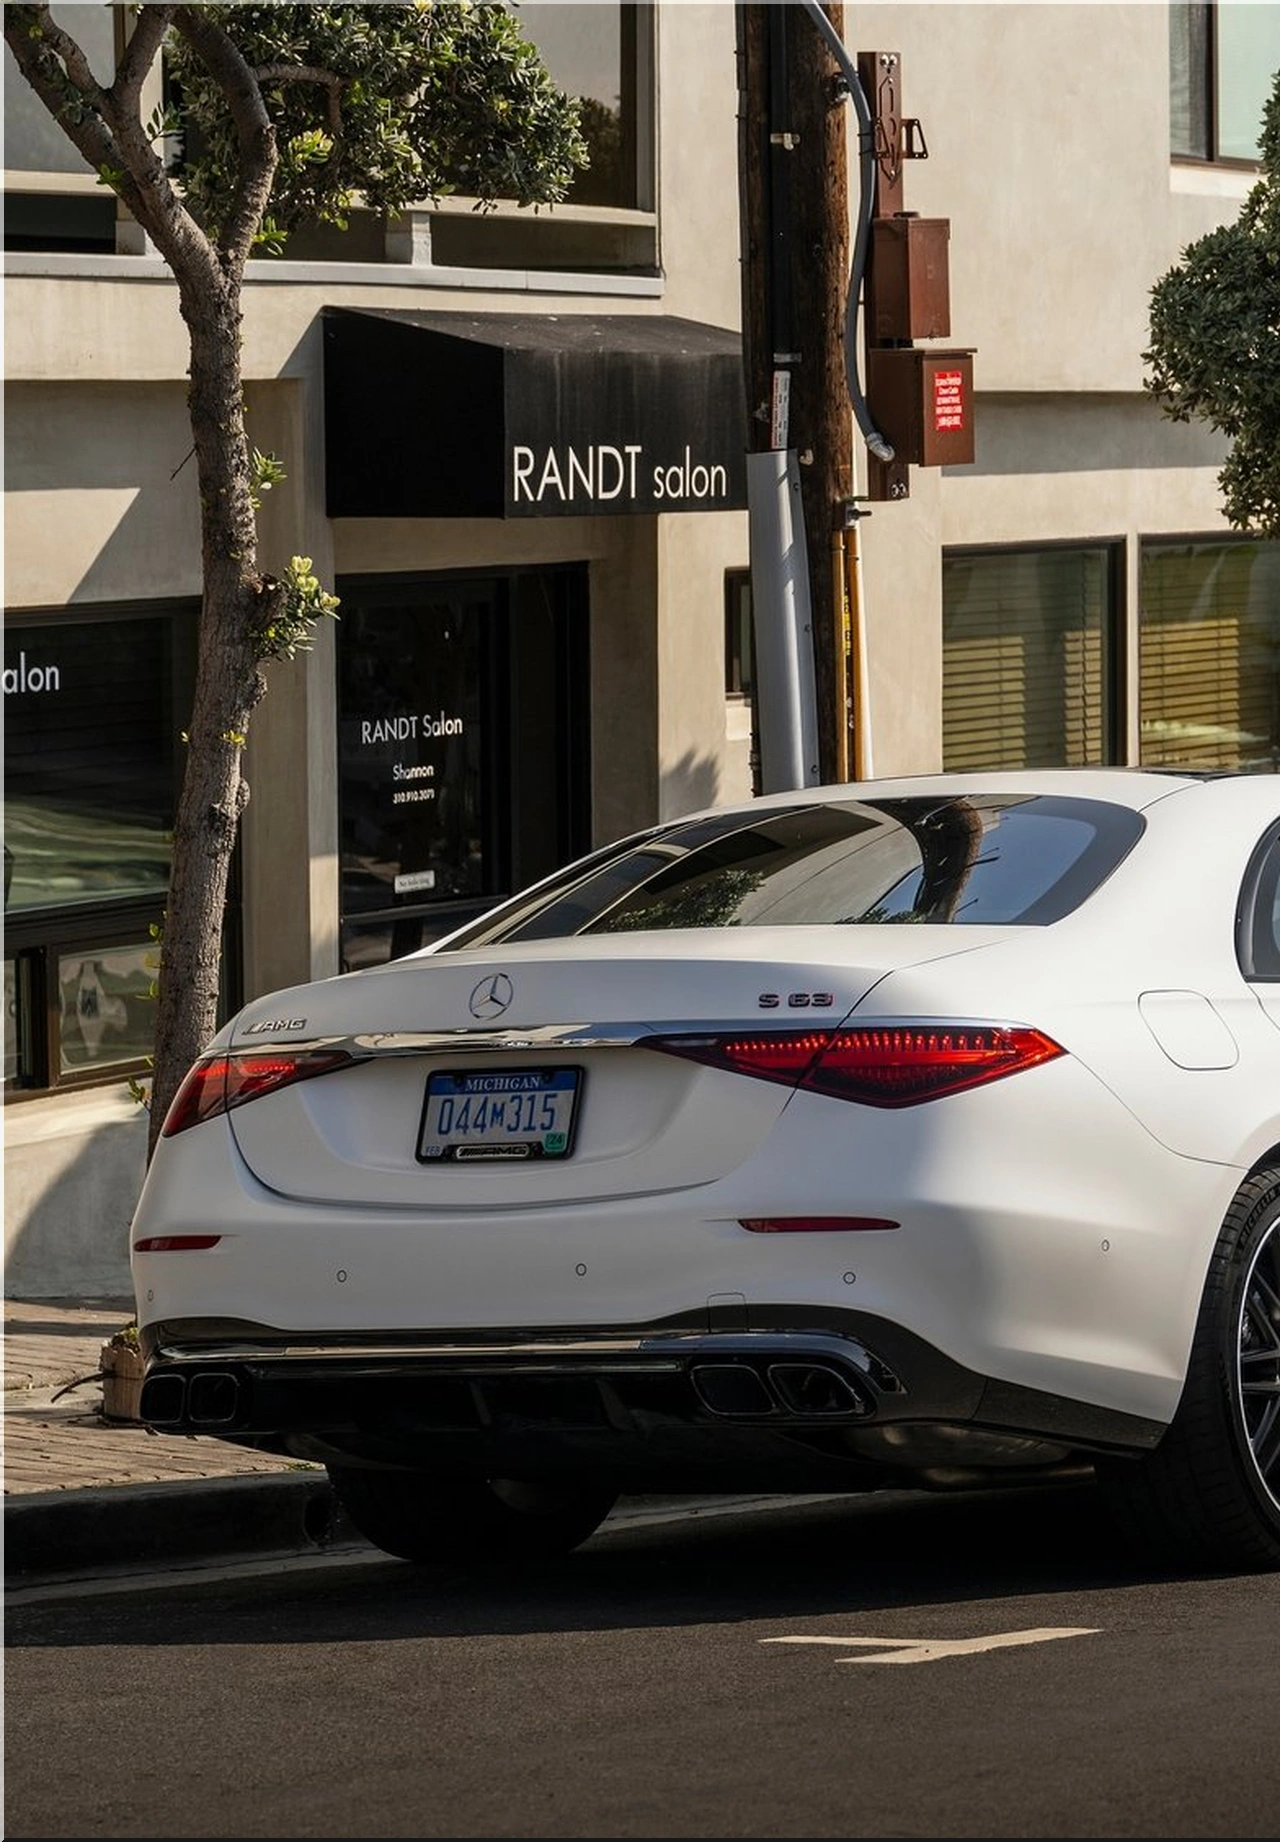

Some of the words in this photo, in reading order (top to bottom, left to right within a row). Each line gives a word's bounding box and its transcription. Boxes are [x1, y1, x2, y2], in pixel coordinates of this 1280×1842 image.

[513, 445, 642, 501] RANDT
[653, 445, 727, 499] salon
[361, 716, 418, 744] RANDT
[423, 710, 463, 737] Salon
[393, 763, 435, 780] Shannon
[758, 993, 780, 1009] S
[788, 993, 833, 1008] 63
[465, 1076, 541, 1092] MICHIGAN
[438, 1094, 557, 1136] 044M315
